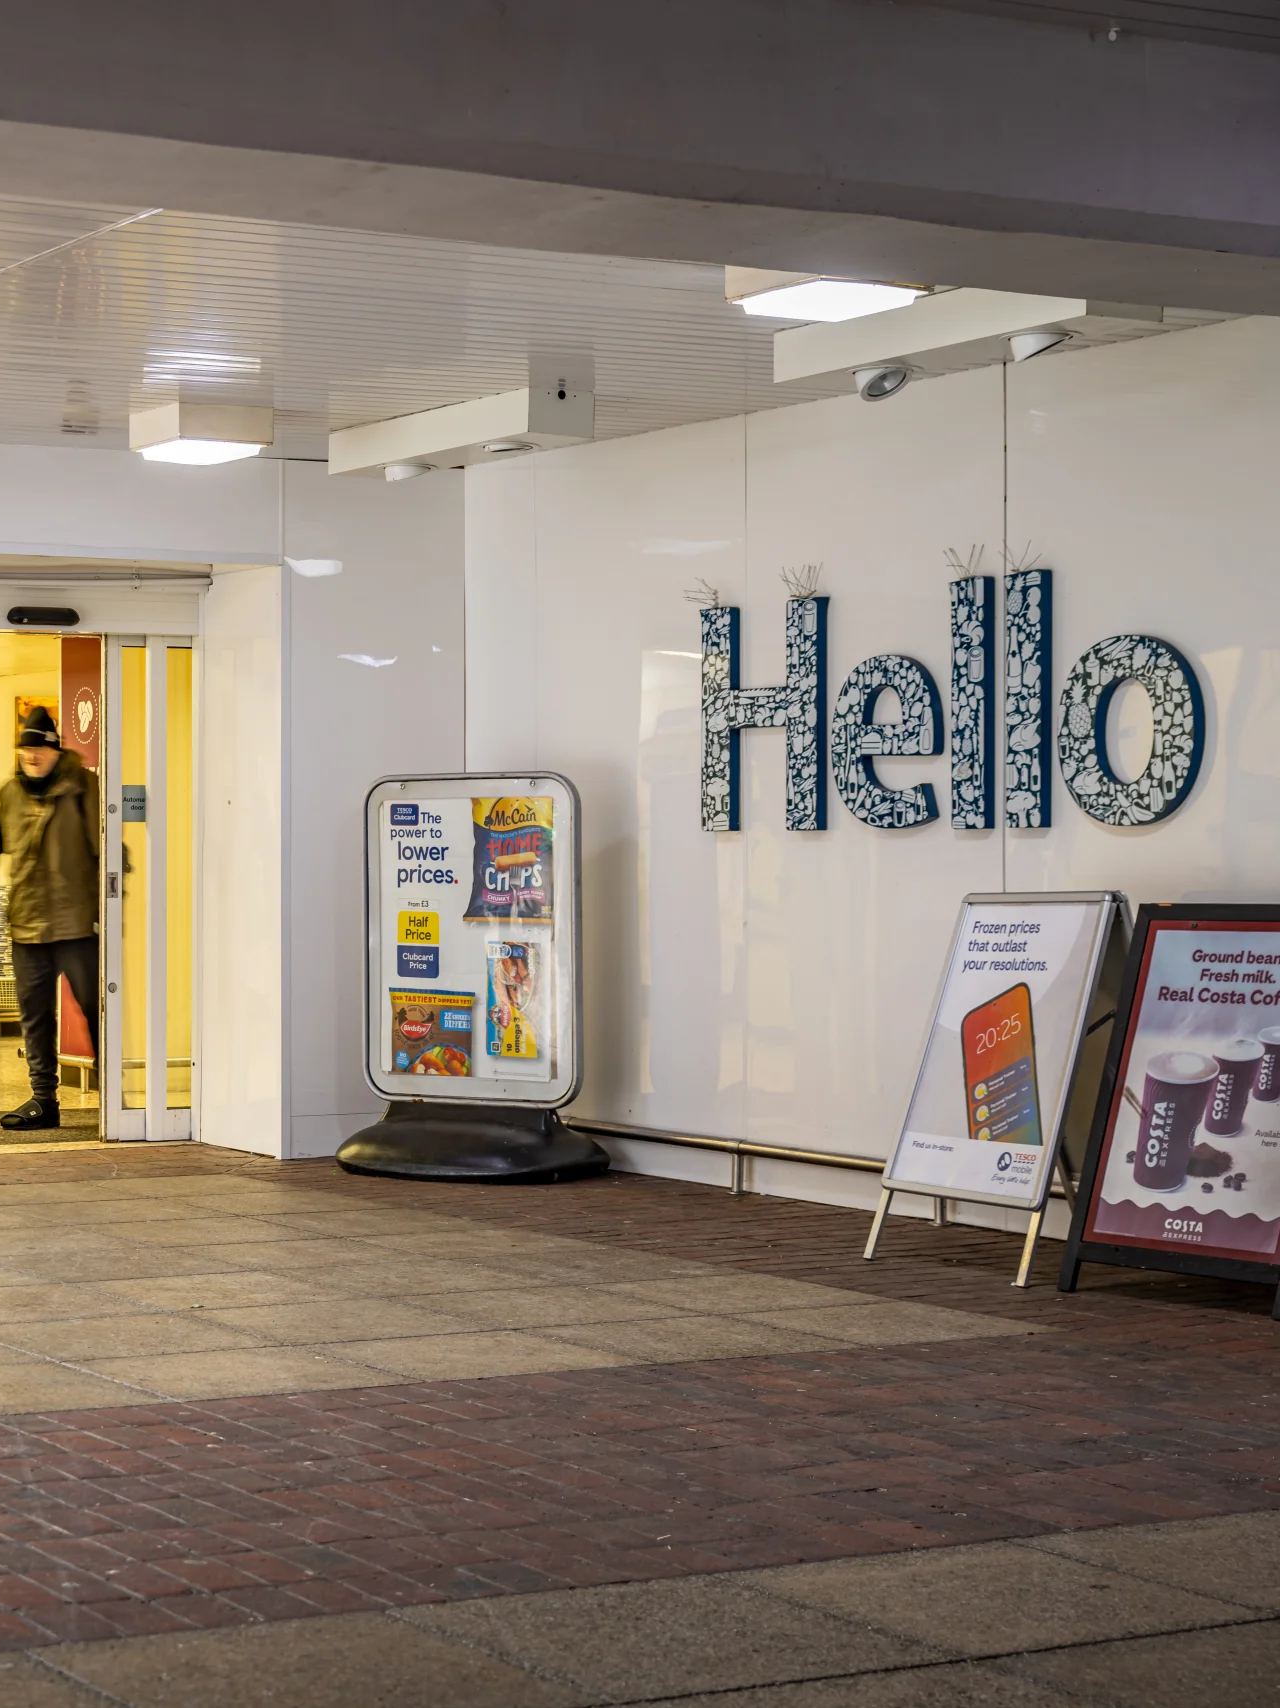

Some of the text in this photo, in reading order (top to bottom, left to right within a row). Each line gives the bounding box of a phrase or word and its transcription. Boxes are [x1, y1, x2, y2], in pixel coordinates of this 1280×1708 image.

[699, 569, 1205, 830] Hello
[421, 812, 442, 824] The
[493, 808, 537, 826] McCain
[391, 828, 442, 840] power to
[398, 841, 449, 861] lower
[486, 833, 543, 860] HOME
[398, 864, 458, 888] prices.
[485, 864, 543, 891] CHPS
[409, 916, 429, 927] Half
[972, 921, 1041, 937] Frozen prices
[405, 929, 431, 940] Price
[968, 939, 1028, 952] that outlast
[402, 952, 433, 961] Clubcard
[1192, 949, 1280, 964] Ground bean
[409, 962, 427, 970] Price
[962, 958, 1048, 973] your resolutions.
[1200, 969, 1276, 984] Fresh milk.
[405, 995, 437, 1003] TASTIEST
[1158, 986, 1280, 1005] Real Costa Cof
[403, 1024, 426, 1033] BirdsEye
[976, 1013, 1021, 1054] 20:25
[514, 1024, 522, 1053] omega
[506, 1043, 512, 1052] 10
[1258, 1054, 1271, 1090] COSTA
[1212, 1074, 1229, 1120] COSTA
[1224, 1074, 1234, 1113] EXPRESS
[1144, 1102, 1168, 1168] COSTA
[1160, 1102, 1175, 1160] EXPRESS
[912, 1140, 925, 1148] Find
[1261, 1139, 1277, 1147] here
[1014, 1153, 1036, 1161] TESCO
[1011, 1165, 1032, 1175] mobile
[1164, 1219, 1203, 1233] COSTA
[1167, 1232, 1202, 1242] EXPRESS
